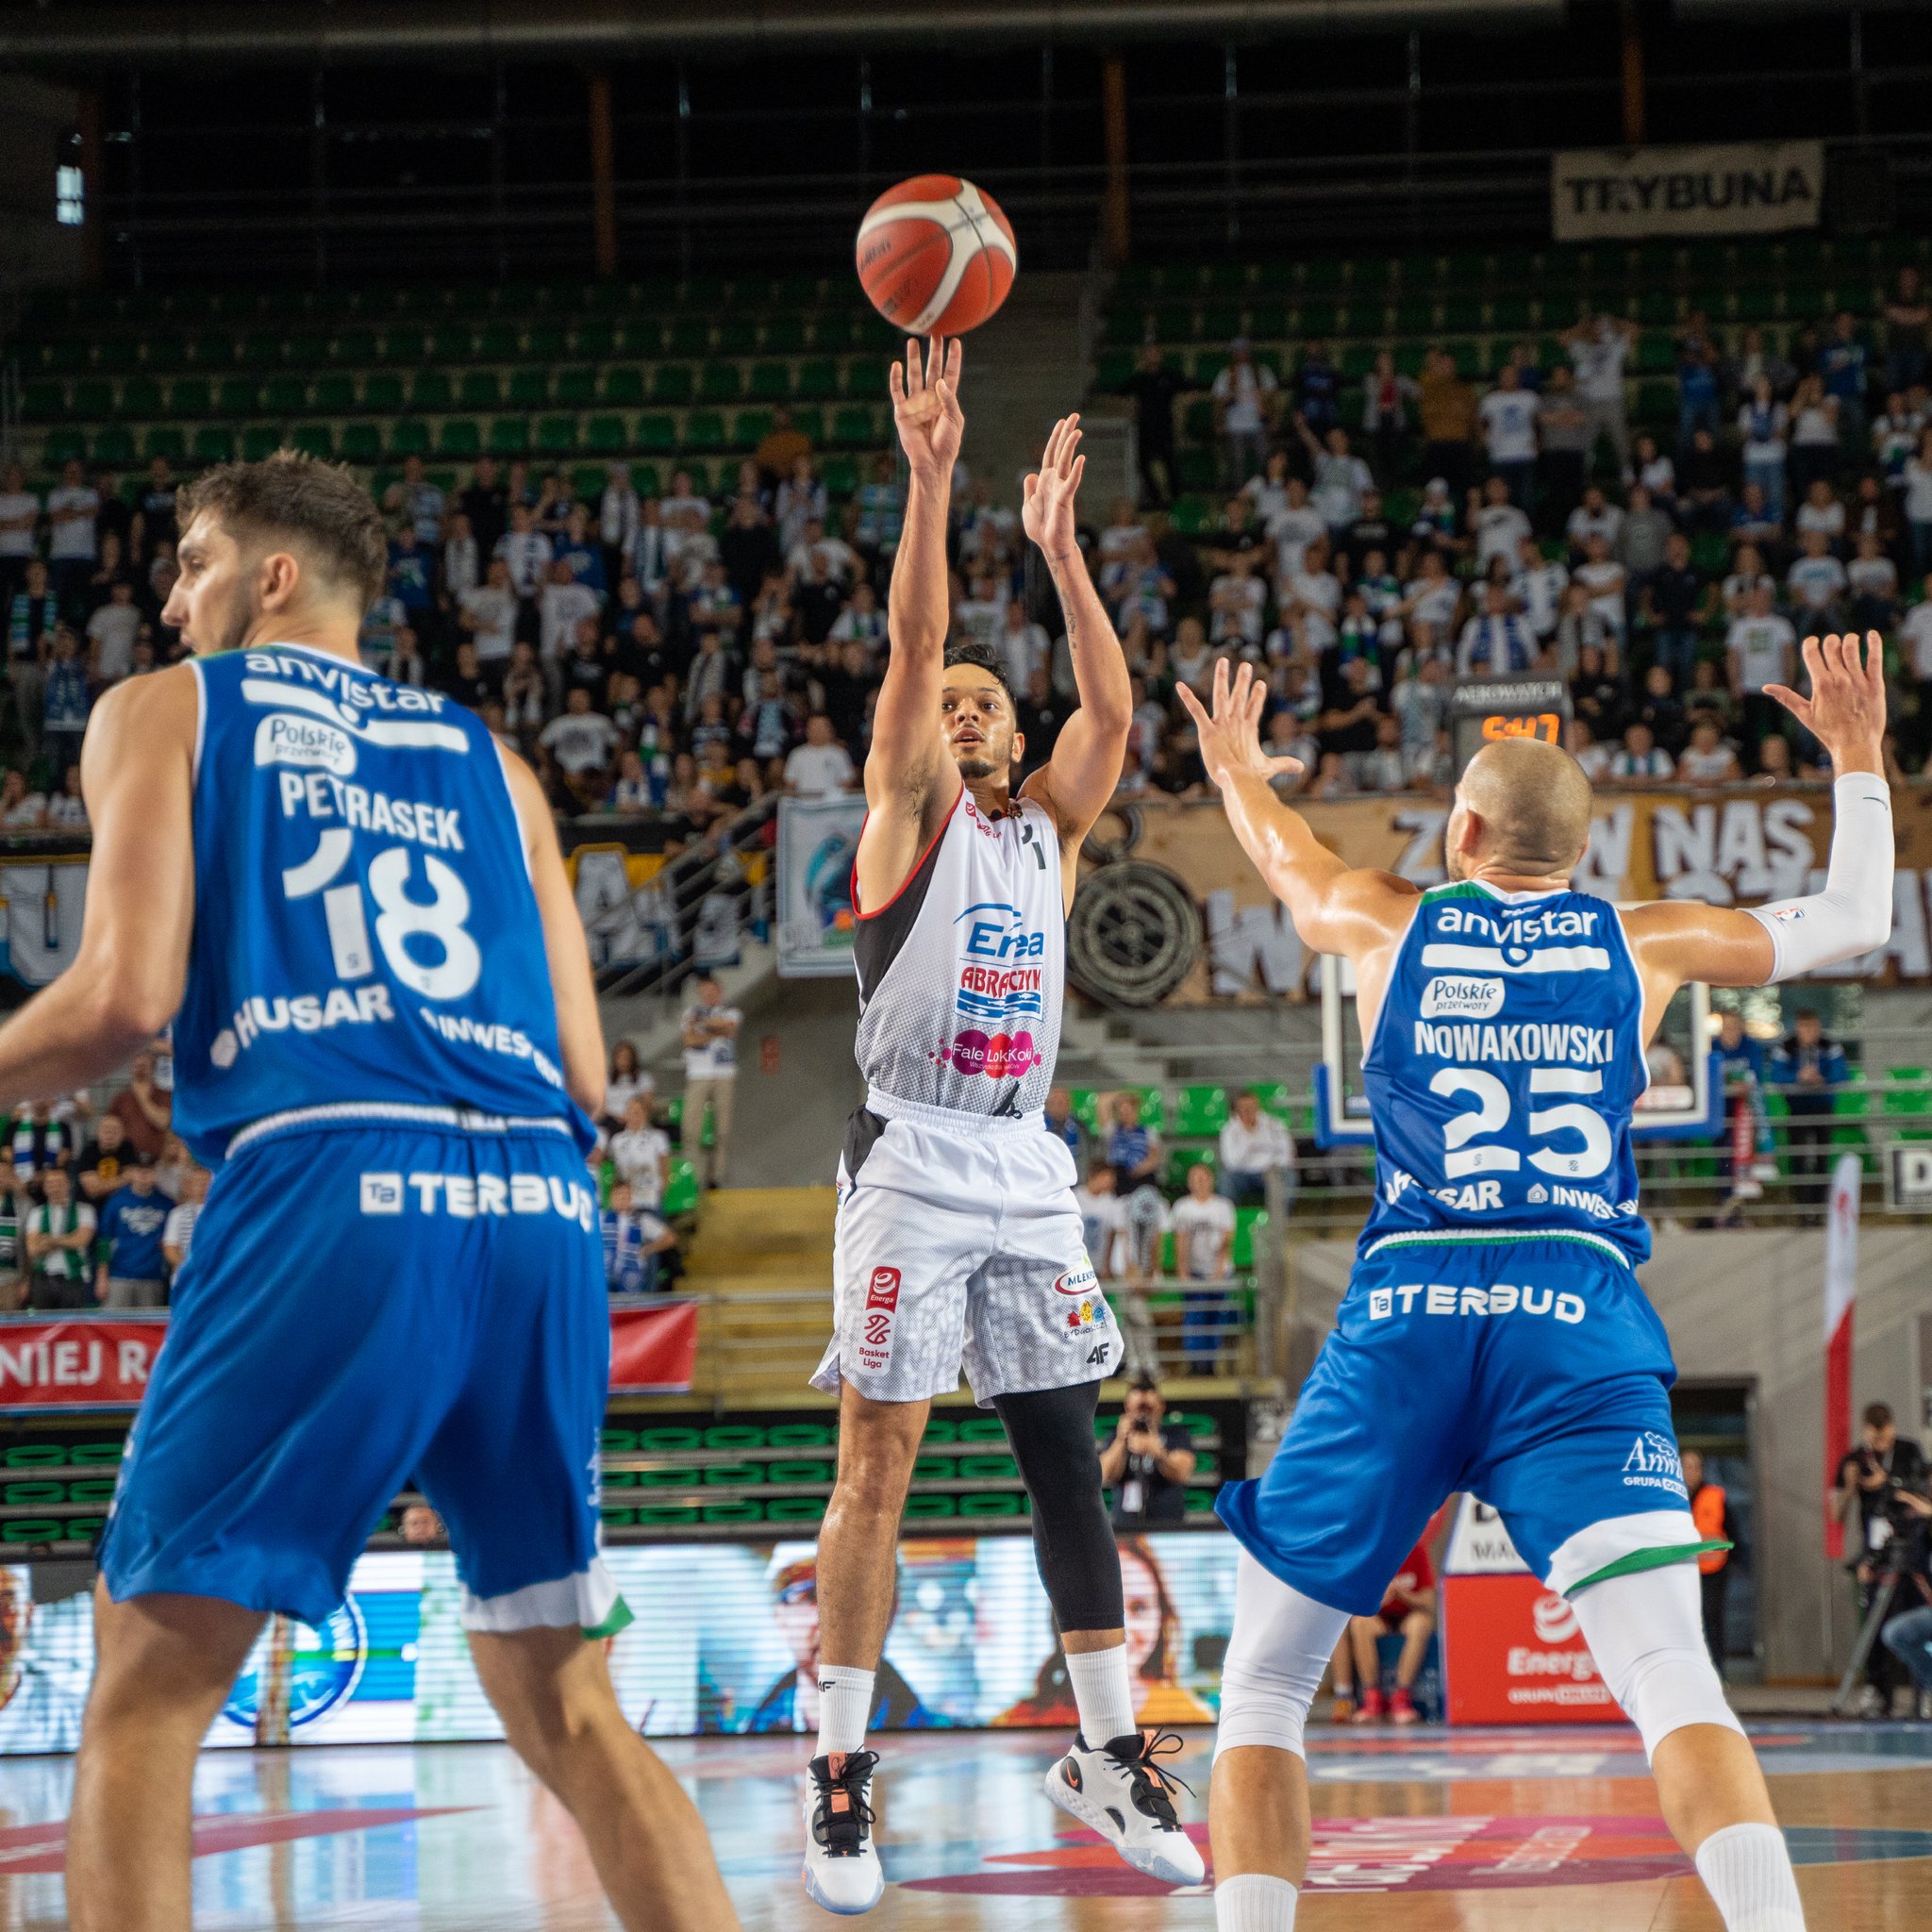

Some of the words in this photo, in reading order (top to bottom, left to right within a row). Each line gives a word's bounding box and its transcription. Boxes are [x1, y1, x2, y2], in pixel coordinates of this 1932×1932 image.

[1565, 167, 1811, 213] TRYBUNA
[244, 653, 446, 714] anvistar
[270, 718, 346, 753] Polskie
[278, 771, 465, 851] PETRASEK
[282, 827, 482, 1001] 18
[1437, 907, 1599, 943] anvistar
[1433, 979, 1497, 1002] Polskie
[1436, 1000, 1490, 1012] przetwory
[234, 983, 395, 1050] HUSAR
[952, 1042, 984, 1061] Fale
[1415, 1021, 1614, 1064] NOWAKOWSKI
[1429, 1068, 1612, 1179] 25
[870, 1293, 894, 1305] Energa
[1395, 1284, 1587, 1324] TERBUD
[858, 1347, 890, 1358] Basket
[863, 1357, 883, 1369] Liga
[1086, 1342, 1110, 1365] 4F
[1623, 1476, 1663, 1489] GRUPA
[1507, 1646, 1602, 1681] Energ
